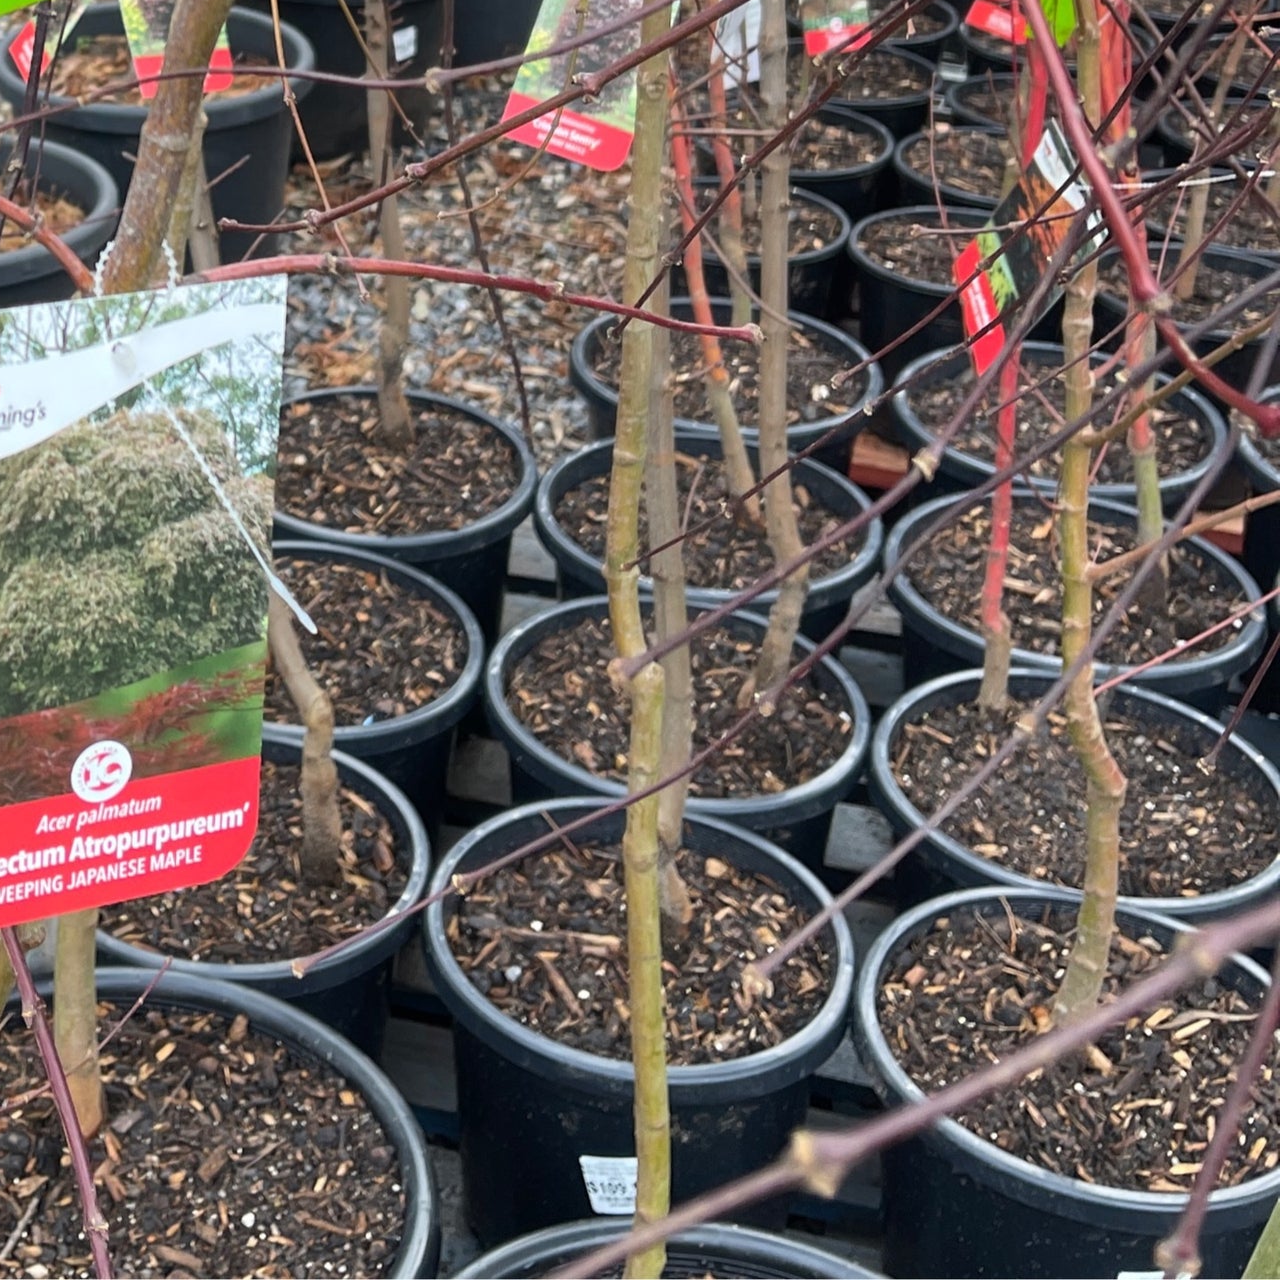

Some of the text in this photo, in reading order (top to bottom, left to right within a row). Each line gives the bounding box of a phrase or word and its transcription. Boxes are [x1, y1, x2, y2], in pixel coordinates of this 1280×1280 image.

[36, 795, 162, 834] Acer palmatum
[69, 801, 250, 862] Atropurpureum'
[66, 858, 146, 890] JAPANESE
[150, 845, 202, 872] MAPLE
